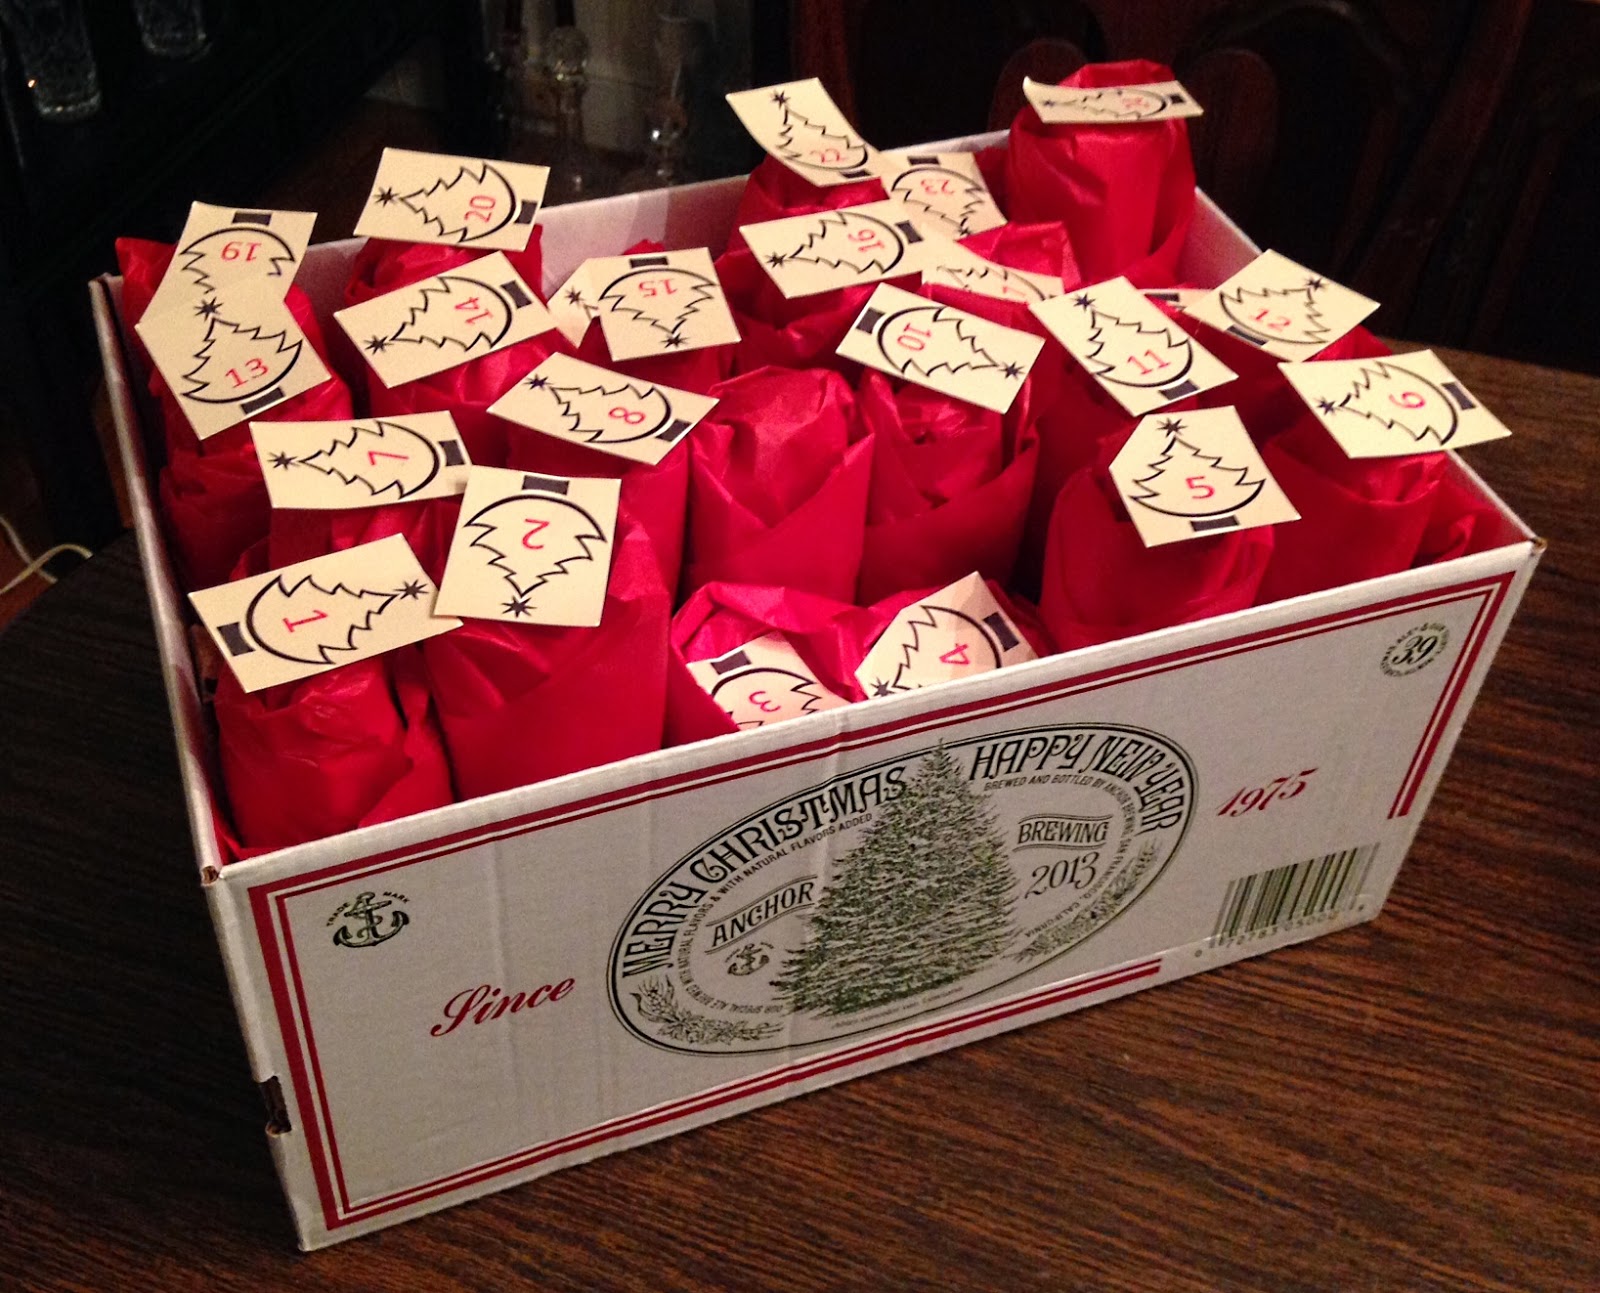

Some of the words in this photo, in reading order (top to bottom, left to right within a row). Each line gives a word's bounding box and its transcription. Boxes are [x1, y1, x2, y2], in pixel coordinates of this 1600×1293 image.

[920, 178, 954, 195] 23
[464, 194, 497, 223] 20
[220, 240, 262, 262] 19
[847, 228, 884, 254] 16
[638, 279, 676, 298] 15
[454, 296, 491, 326] 14
[1253, 307, 1292, 333] 12
[895, 322, 933, 352] 10
[225, 357, 270, 389] 13
[1126, 349, 1171, 377] 11
[607, 406, 647, 426] 8
[366, 449, 409, 467] 7
[1185, 475, 1216, 500] 5
[521, 518, 551, 551] 2
[282, 608, 329, 633] 1
[939, 642, 972, 667] 4
[1391, 635, 1439, 666] 39
[748, 690, 782, 713] 3
[968, 733, 1096, 781] HAPPY
[1077, 735, 1167, 783] NEW
[1133, 761, 1185, 837] YEAR
[983, 776, 1027, 792] BREWED
[1028, 773, 1051, 785] AND
[1051, 774, 1094, 786] BOTTLED
[1215, 767, 1319, 818] 1975
[1017, 820, 1110, 845] BREWING
[717, 875, 745, 895] WITH
[742, 849, 788, 878] NATURAL
[789, 824, 836, 852] FLAVORS
[838, 812, 873, 832] ADDED
[622, 880, 709, 978] MERRY
[689, 765, 907, 884] CHRISTMAS
[1024, 851, 1100, 899] 2013
[326, 901, 351, 927] TRADE
[712, 881, 815, 948] ANCHOR
[430, 977, 576, 1037] Since
